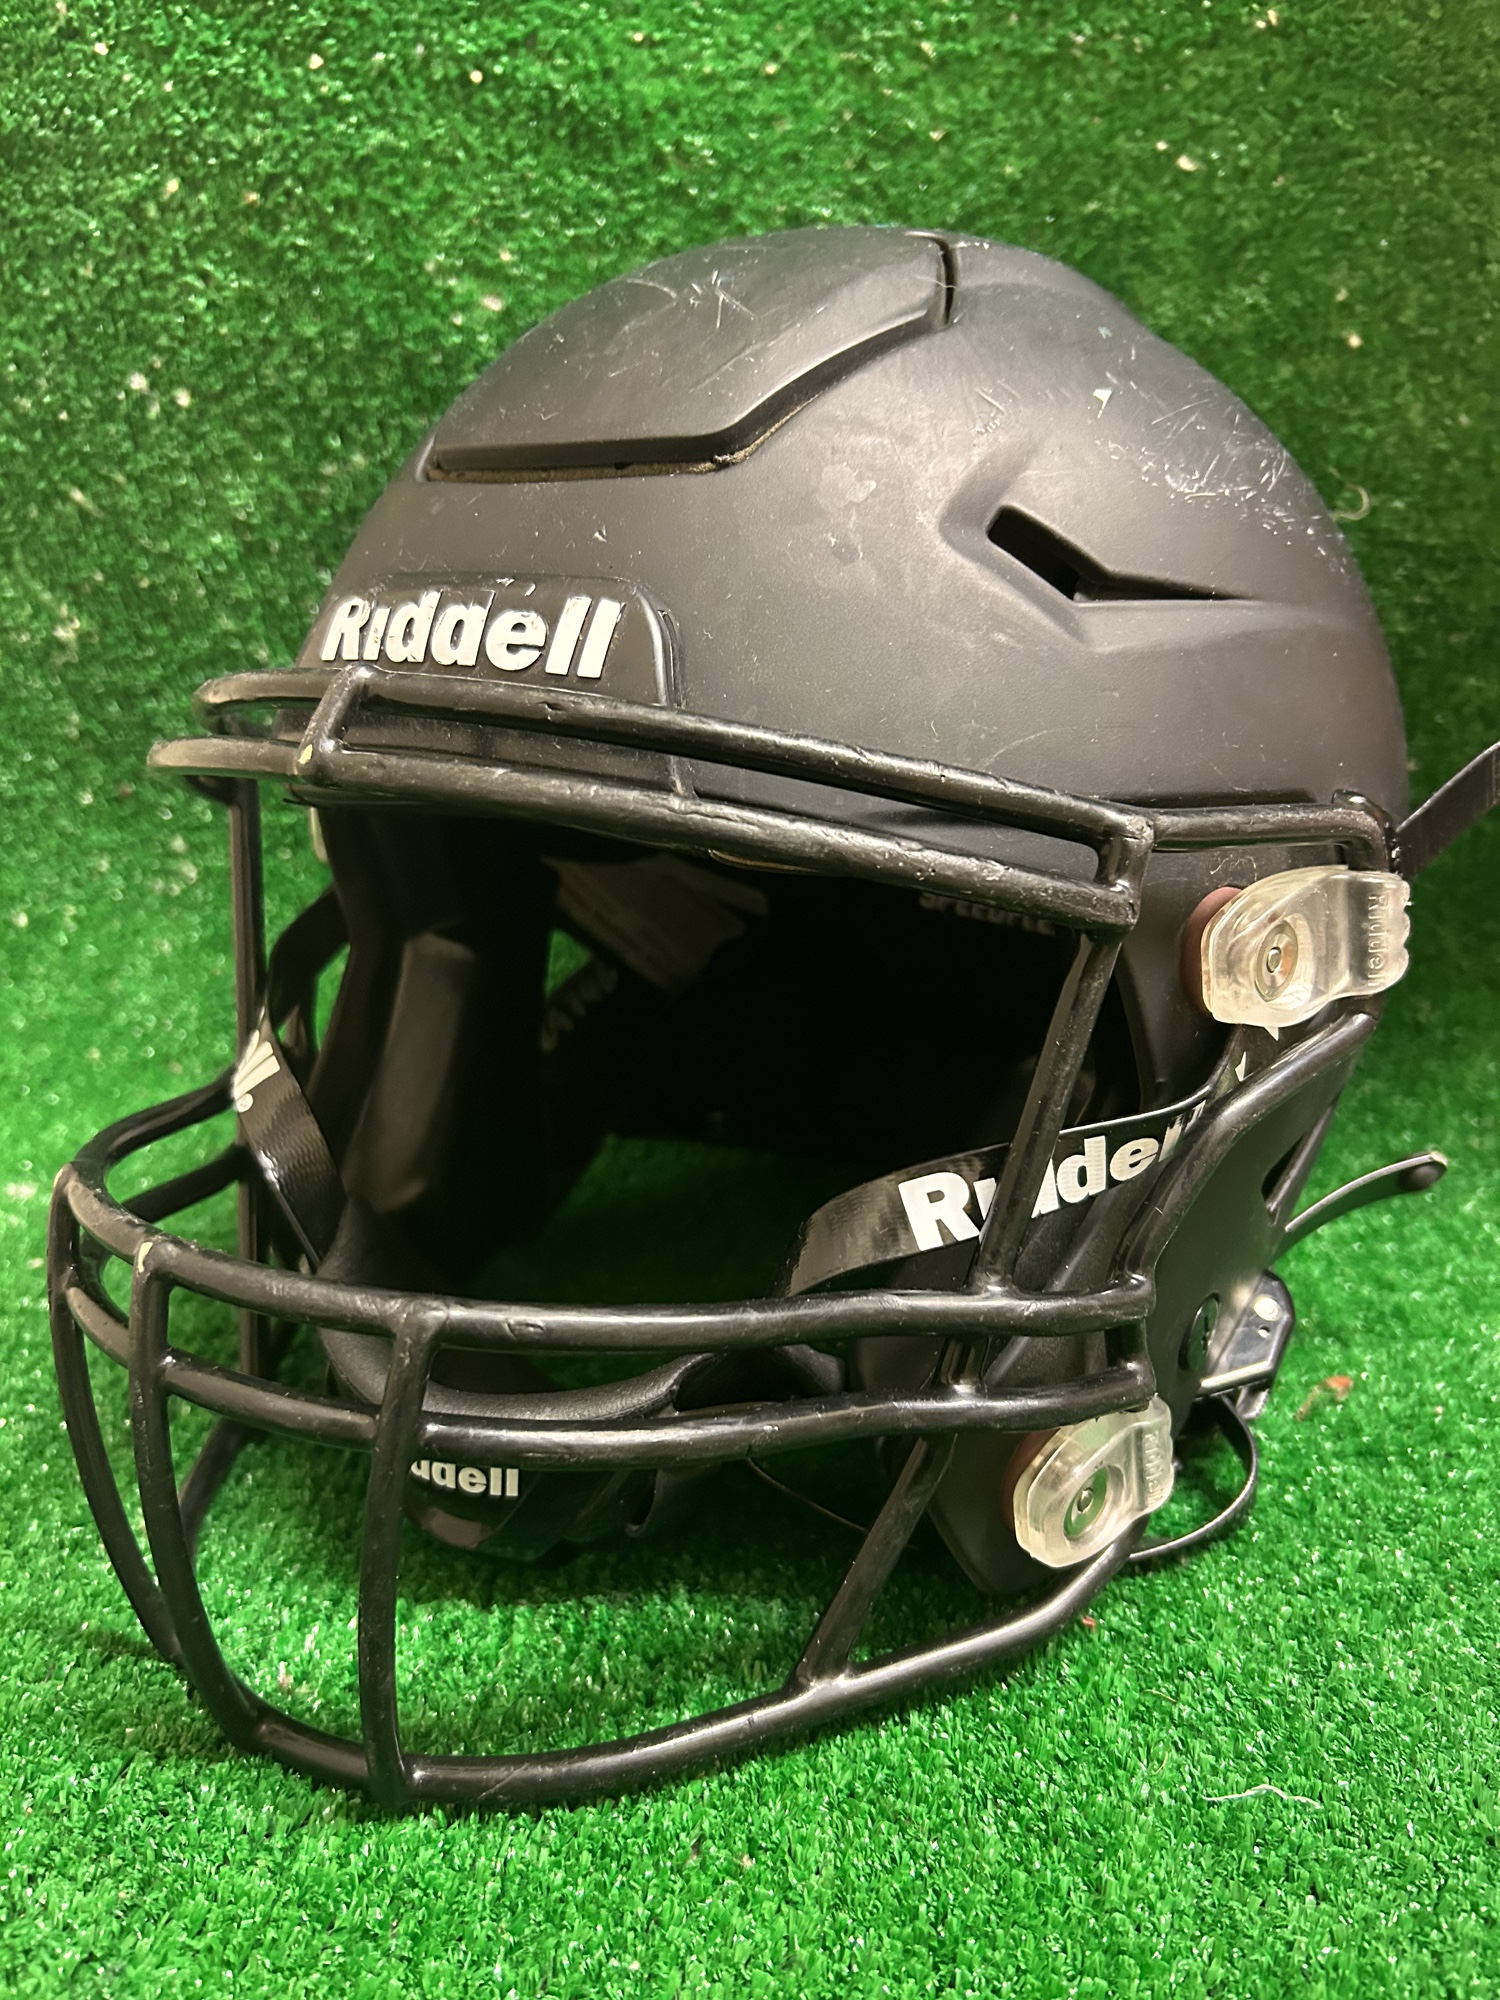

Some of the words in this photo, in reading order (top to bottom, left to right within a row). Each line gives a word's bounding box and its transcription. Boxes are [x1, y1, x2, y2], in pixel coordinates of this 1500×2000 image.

[320, 588, 626, 679] Riddell
[1367, 893, 1390, 987] Riddell
[410, 1459, 519, 1497] ddell
